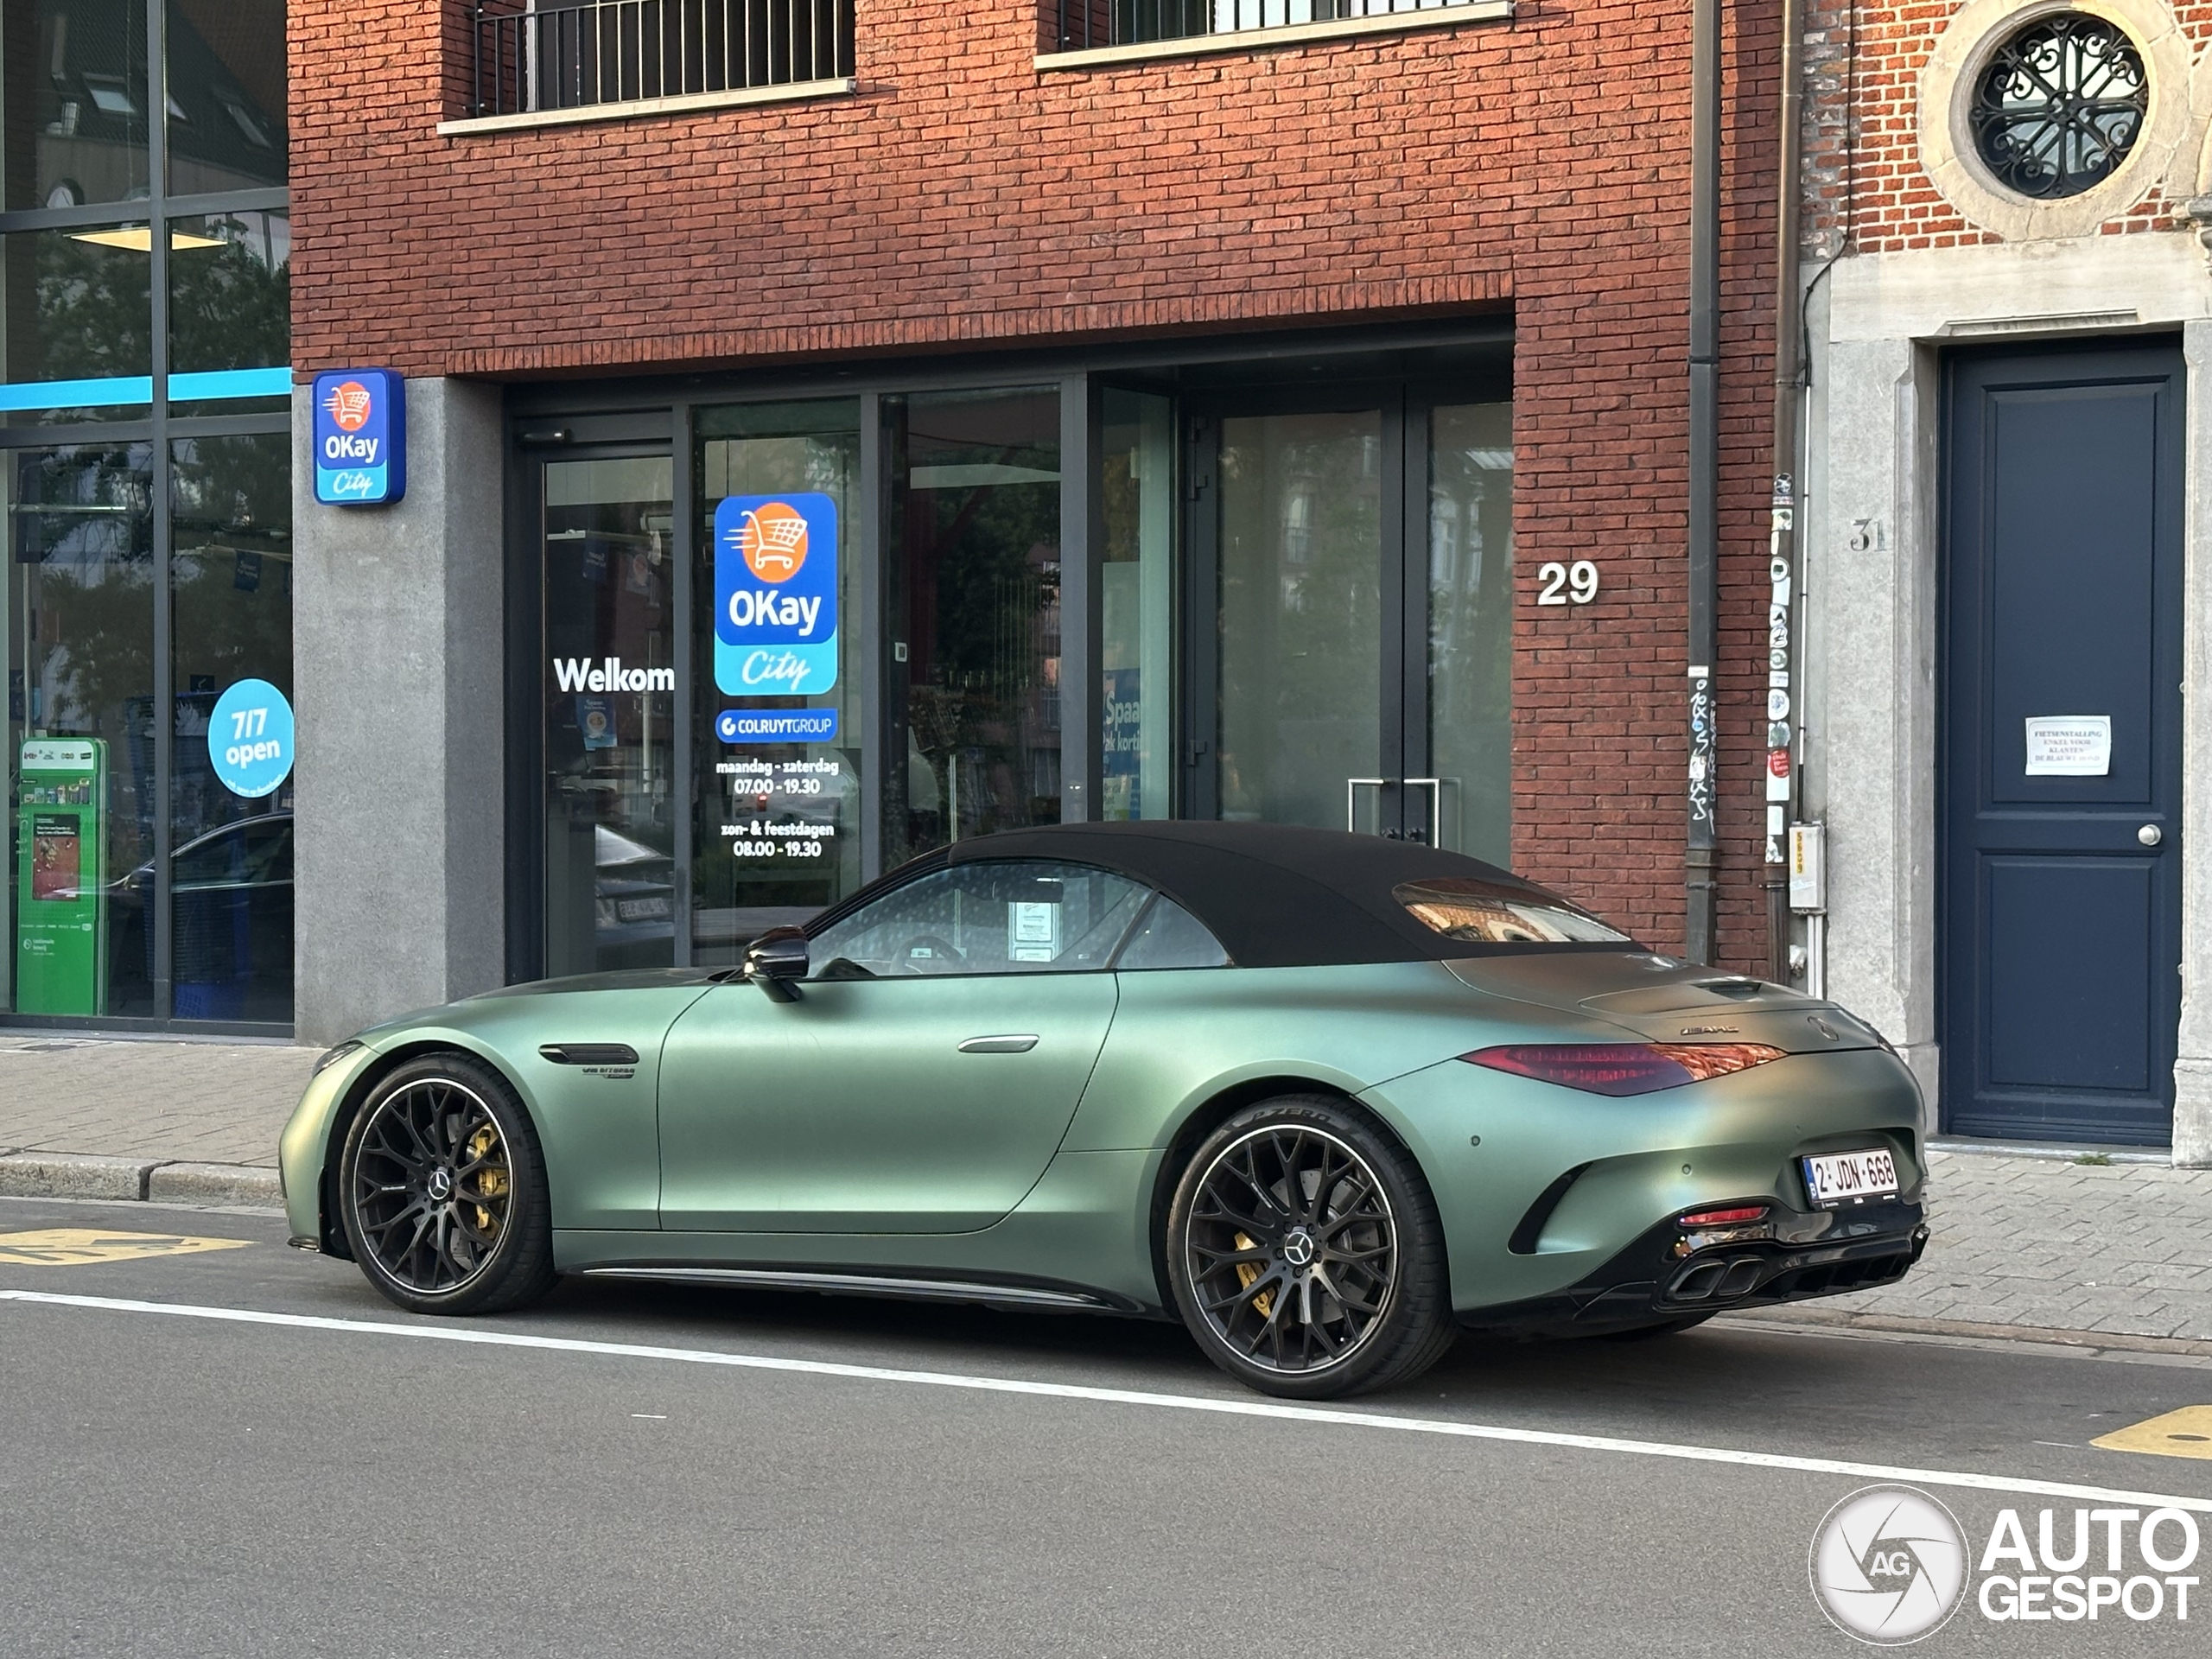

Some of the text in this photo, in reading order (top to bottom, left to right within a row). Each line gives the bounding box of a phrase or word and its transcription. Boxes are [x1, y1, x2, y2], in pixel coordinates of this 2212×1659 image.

[325, 435, 378, 464] OKay
[333, 472, 373, 497] City
[1850, 518, 1887, 552] 31
[1538, 560, 1598, 605] 29
[729, 589, 822, 637] OKay
[553, 657, 675, 692] Welkom
[741, 651, 811, 691] City
[738, 718, 832, 734] COLRUYTGROUP
[226, 740, 281, 769] open
[715, 758, 772, 776] maandag
[783, 757, 839, 776] zaterdag
[734, 779, 773, 794] 07.00
[784, 779, 820, 794] 19.30
[721, 820, 835, 839] zon- & feestdagen
[733, 841, 775, 857] 08.00
[785, 841, 822, 857] 19.30
